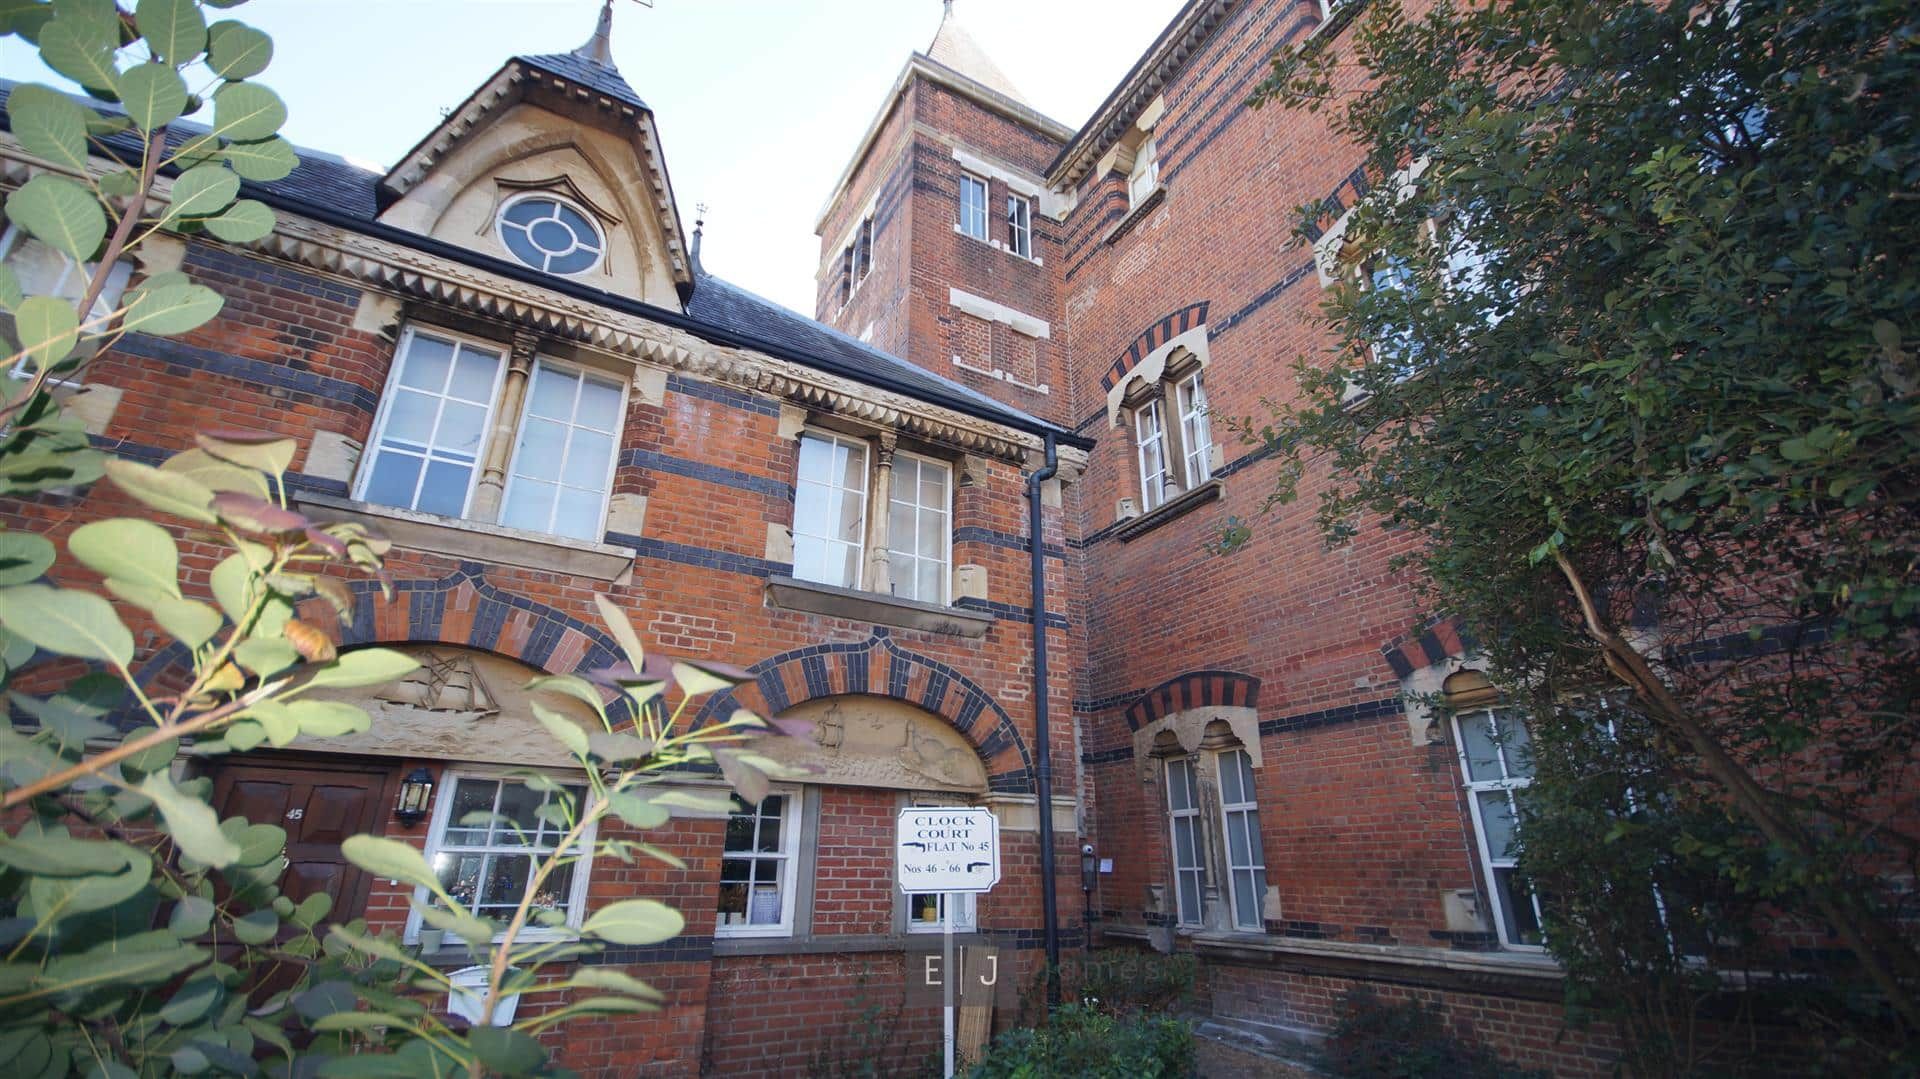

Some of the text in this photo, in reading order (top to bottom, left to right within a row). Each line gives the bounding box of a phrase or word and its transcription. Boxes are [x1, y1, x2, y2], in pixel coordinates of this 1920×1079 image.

[286, 808, 303, 819] 45
[914, 816, 976, 826] CLOCK
[917, 829, 972, 839] COURT
[927, 842, 990, 852] FLAT No 45
[903, 864, 921, 873] Nos
[925, 864, 937, 873] 46
[949, 864, 961, 873] 66
